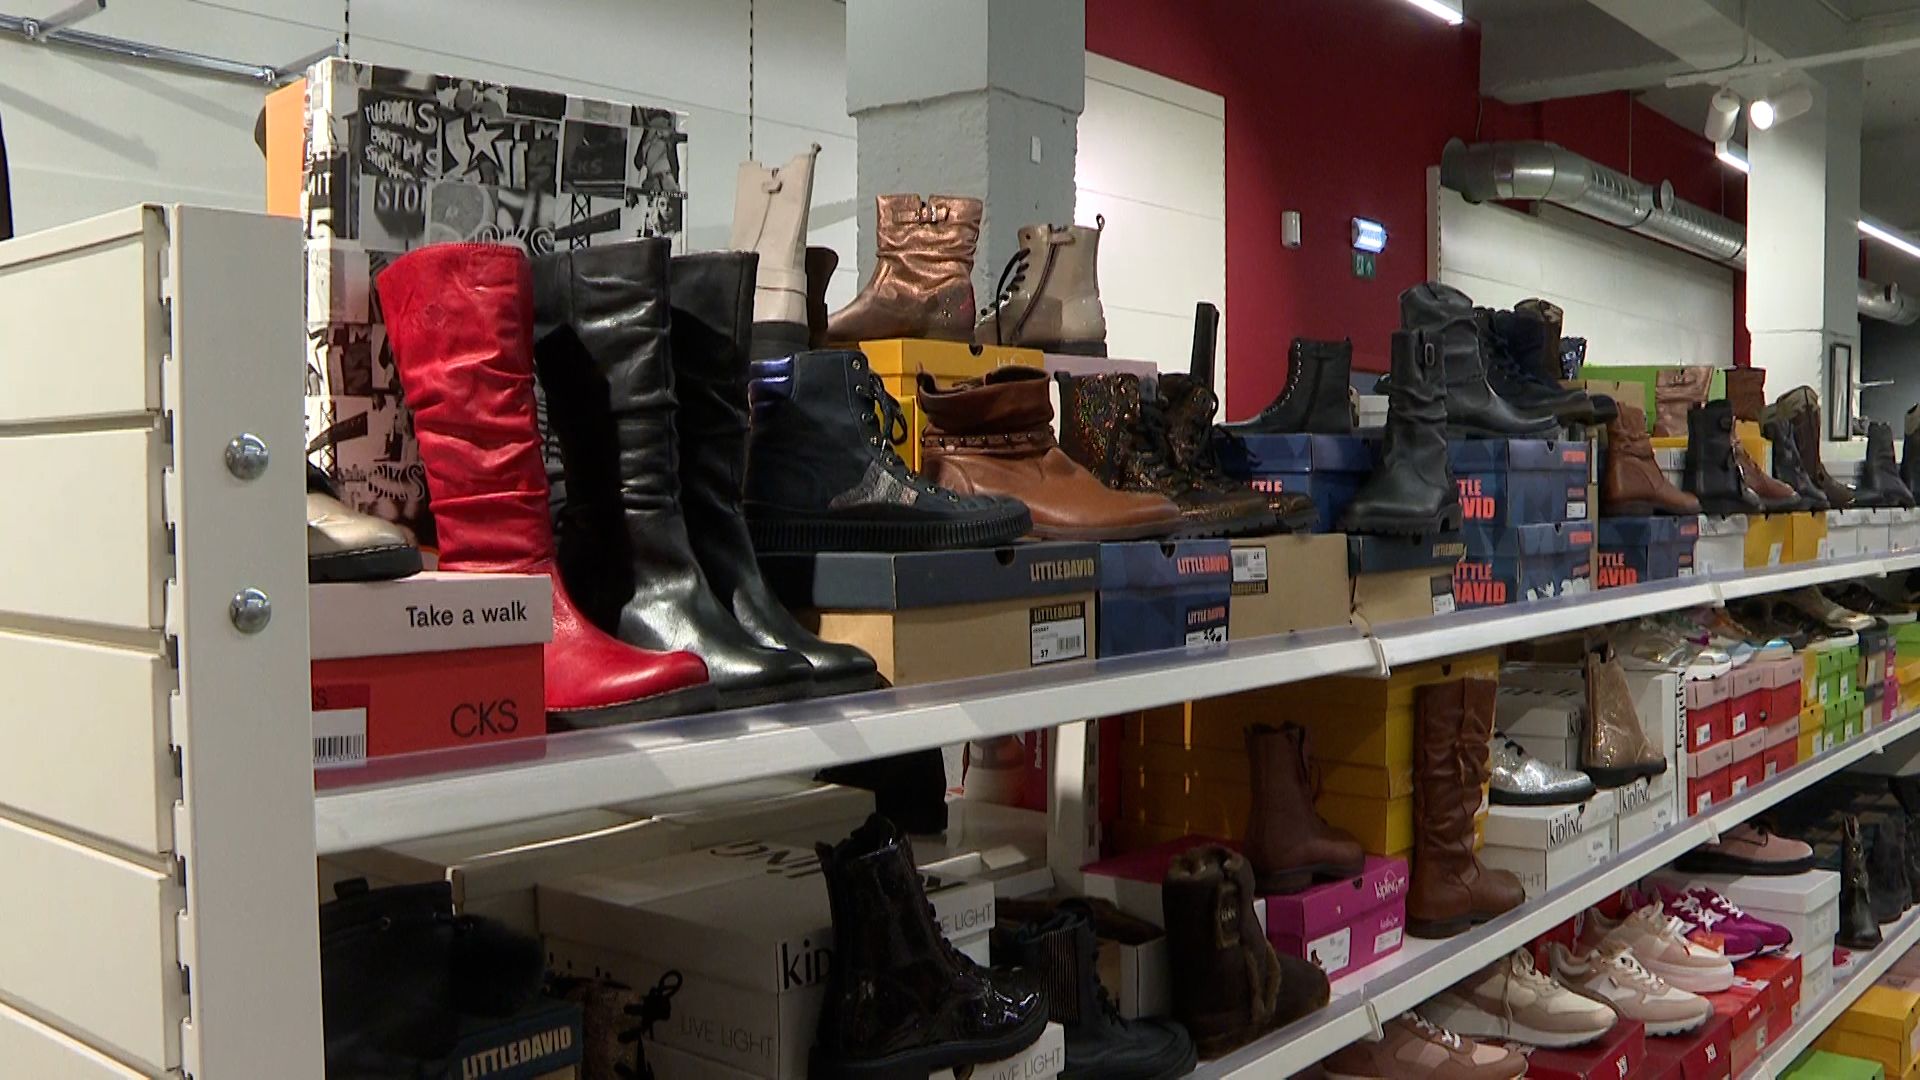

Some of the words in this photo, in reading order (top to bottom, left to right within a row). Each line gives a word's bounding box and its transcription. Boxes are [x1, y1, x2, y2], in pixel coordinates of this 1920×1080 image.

[1456, 479, 1482, 497] TLE
[1459, 496, 1496, 520] VID
[1030, 558, 1096, 582] LITTLEDAVID
[1177, 554, 1229, 575] LITTLEDAVID
[1598, 566, 1638, 587] AVID
[405, 603, 454, 628] Take
[462, 608, 475, 626] a
[481, 599, 528, 625] walk
[449, 698, 519, 739] CKS
[954, 903, 993, 932] LIGHT
[462, 1024, 572, 1080] LITTLEDAVID
[720, 1023, 777, 1058] LIGHT
[1024, 1047, 1062, 1078] LIGHT
